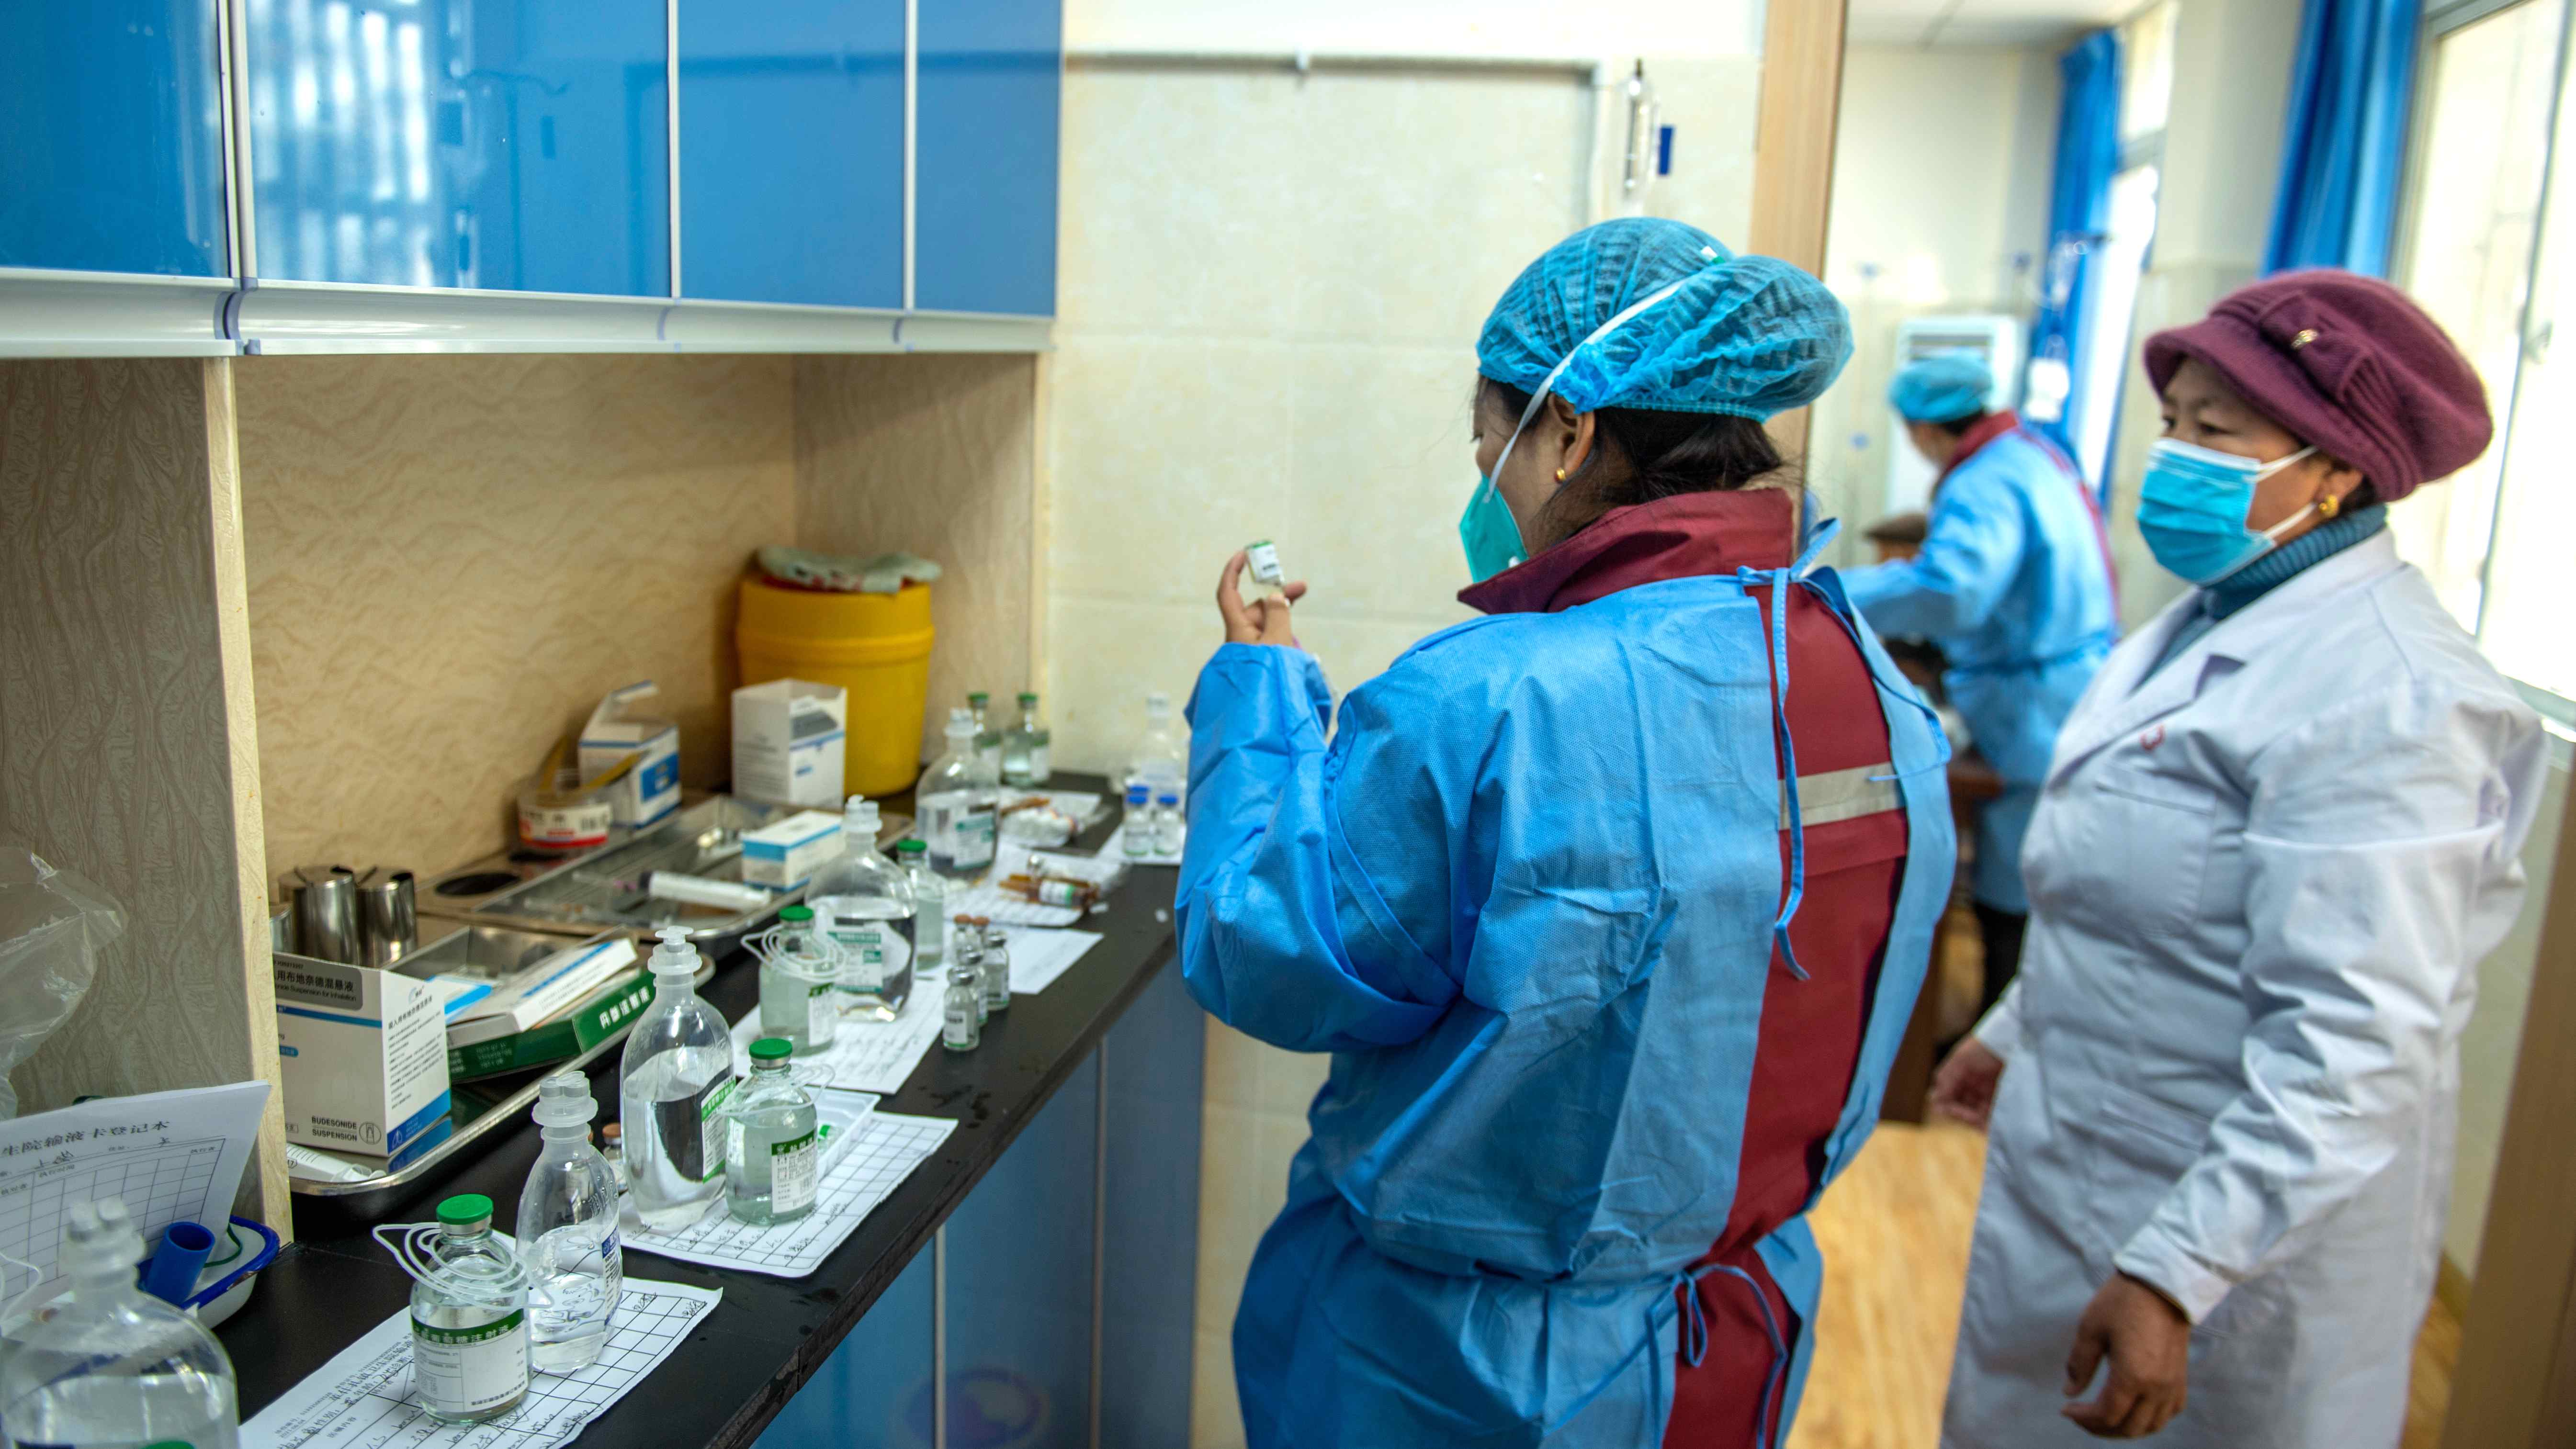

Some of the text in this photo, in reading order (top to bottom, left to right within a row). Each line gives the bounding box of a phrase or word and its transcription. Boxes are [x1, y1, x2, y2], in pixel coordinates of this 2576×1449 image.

[275, 970, 353, 992] 用布地奈德混悬液
[312, 1115, 357, 1130] BUDESONIDE
[312, 1129, 358, 1142] SUSPENSION
